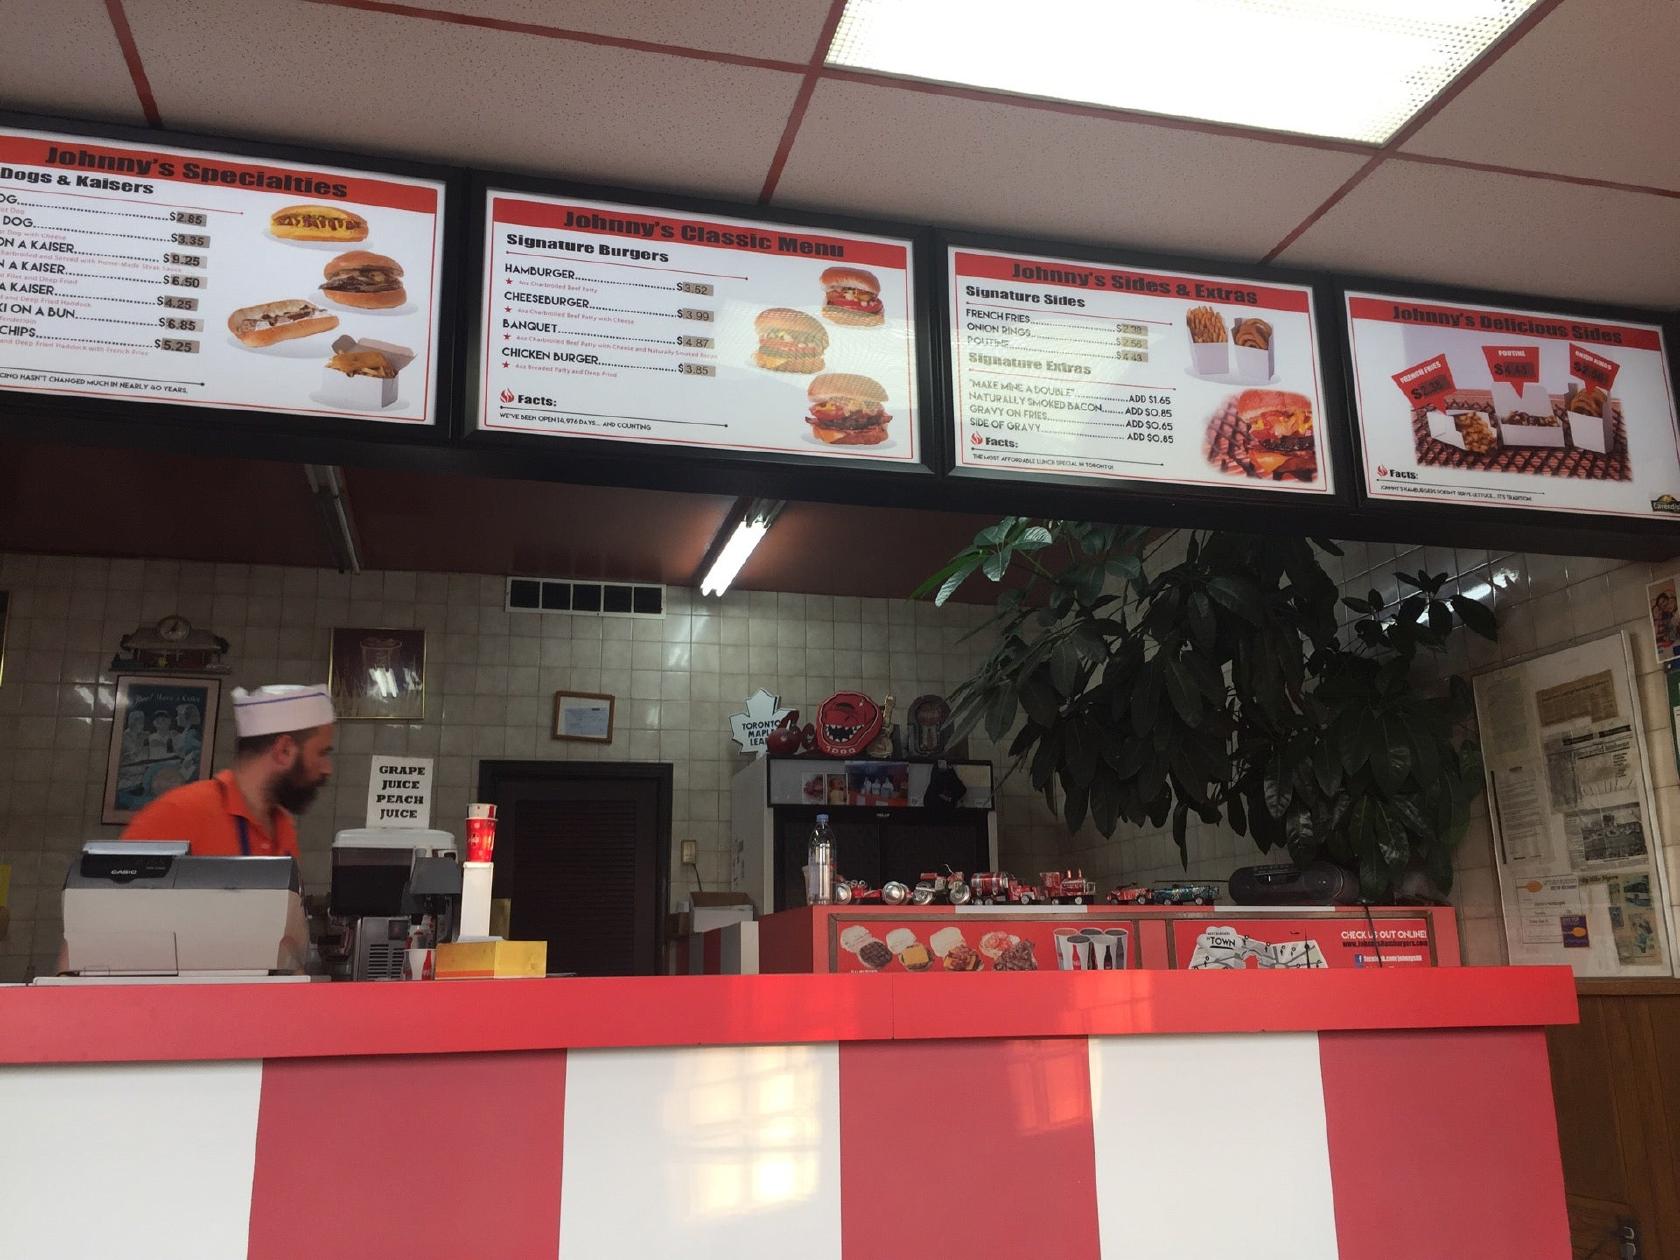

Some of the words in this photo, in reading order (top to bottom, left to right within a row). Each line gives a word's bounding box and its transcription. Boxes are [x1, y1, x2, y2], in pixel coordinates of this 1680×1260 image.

[1, 167, 52, 184] Dogs
[57, 174, 71, 186] &
[76, 174, 154, 194] Kaisers
[45, 146, 175, 177] Johnny's
[183, 161, 347, 198] Specialties
[3, 215, 33, 228] DOG
[171, 233, 204, 247] $3.35
[563, 211, 675, 239] Johnny's
[681, 225, 772, 251] Classic
[778, 234, 845, 258] Menu
[20, 239, 31, 249] A
[31, 240, 74, 254] KAISER
[163, 253, 201, 267] $9.25
[506, 234, 594, 254] Signature
[599, 243, 669, 263] Burgers
[9, 261, 18, 271] A
[21, 262, 66, 275] KAISER
[163, 274, 201, 288] $6.50
[504, 263, 576, 280] HAMBURGER
[676, 281, 708, 295] $3.52
[1012, 264, 1106, 288] Johnny's
[1111, 274, 1171, 294] Sides
[1176, 284, 1191, 297] &
[1195, 283, 1258, 305] Extras
[10, 282, 55, 296] KAISER
[157, 296, 192, 310] $4.25
[504, 291, 590, 309] CHEESEBURGER
[677, 309, 710, 321] $3.99
[966, 285, 1040, 305] Signature
[1043, 294, 1086, 308] Sides
[10, 303, 32, 315] ON
[35, 306, 45, 317] A
[47, 307, 75, 319] BUN
[159, 317, 196, 331] $6.85
[966, 308, 1004, 321] FRENCH
[1004, 313, 1031, 324] FRIES
[1392, 305, 1476, 328] Johnny's
[1479, 314, 1569, 338] Delicious
[1571, 325, 1623, 344] Sides
[0, 324, 36, 338] CHIPS
[154, 338, 193, 352] $5.25
[502, 319, 558, 334] BANQUET
[677, 336, 708, 349] $4.87
[967, 322, 999, 333] ONION
[1001, 325, 1031, 337] RINGS
[502, 347, 550, 361] CHICKEN
[553, 351, 599, 365] BURGER
[678, 363, 709, 376] $3.85
[968, 352, 1043, 370] Signature
[1046, 361, 1092, 375] Extras
[49, 375, 86, 386] CHANGED
[87, 379, 110, 388] MUCH
[119, 382, 149, 391] NEARLY
[1000, 382, 1024, 392] MINE
[1128, 395, 1147, 405] ADD
[1148, 395, 1171, 405] $1.65
[517, 395, 557, 407] Facts:
[968, 391, 1027, 406] NATURALLY
[1027, 396, 1066, 409] SMOKED
[1067, 401, 1103, 413] BACON
[1125, 406, 1144, 417] ADD
[1145, 407, 1173, 418] $0.85
[521, 413, 537, 423] BEEN
[538, 415, 556, 424] OPEN
[617, 422, 652, 431] COUNTING
[969, 404, 1005, 418] GRAVY
[1006, 408, 1022, 418] ON
[1023, 409, 1048, 421] FRIES
[1125, 419, 1144, 430] ADD
[1145, 420, 1173, 431] $0.65
[969, 417, 990, 429] SIDE
[990, 419, 1005, 430] OF
[1006, 421, 1042, 433] GRAVY
[1126, 432, 1145, 443] ADD
[1147, 433, 1174, 444] $0.85
[985, 436, 1019, 449] Facts:
[1000, 456, 1036, 466] AFFORDABLE
[1389, 468, 1419, 480] Facts:
[742, 719, 781, 731] TORONTO
[748, 729, 774, 738] MAPL
[379, 766, 426, 776] GRAPE
[382, 780, 420, 791] JUICE
[376, 794, 424, 804] PEACH
[380, 809, 418, 820] JUICE
[1210, 936, 1236, 947] TOWN
[1341, 930, 1367, 940] CHECK
[1379, 930, 1397, 940] OUT
[1397, 930, 1428, 939] ONLINE!
